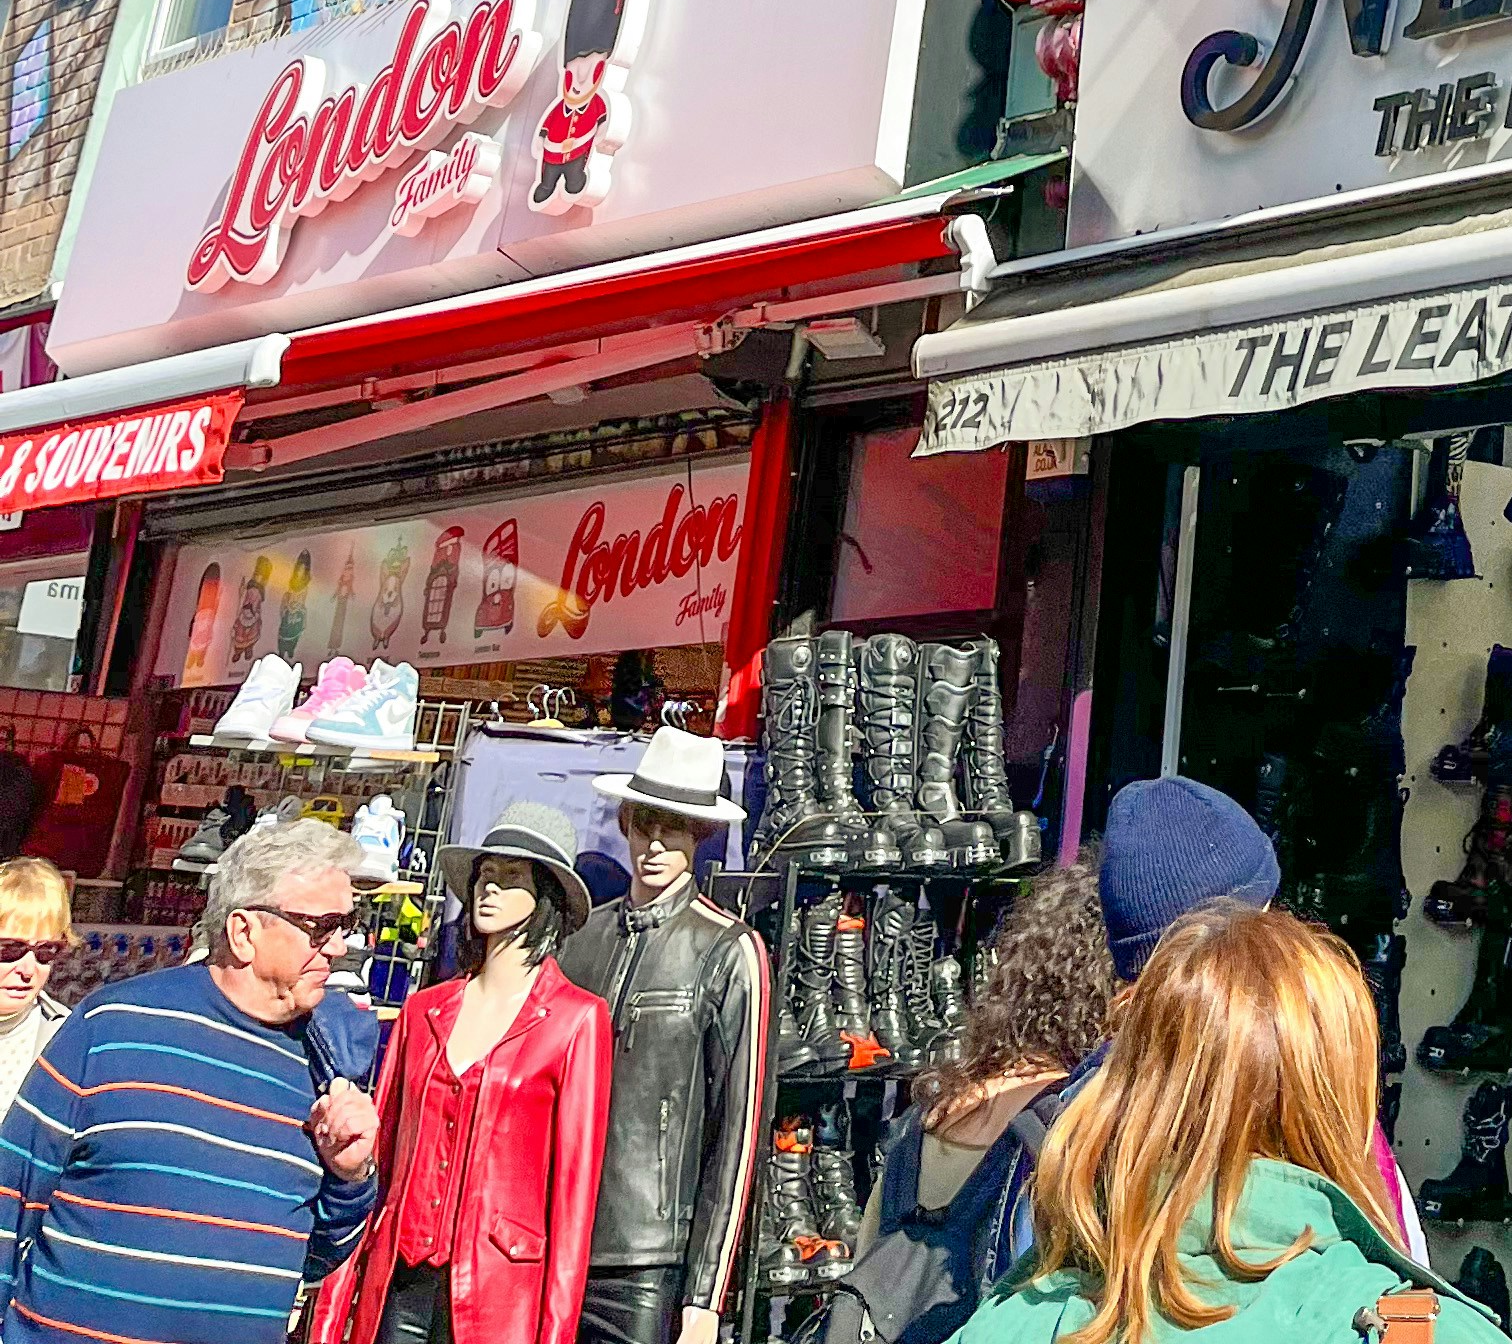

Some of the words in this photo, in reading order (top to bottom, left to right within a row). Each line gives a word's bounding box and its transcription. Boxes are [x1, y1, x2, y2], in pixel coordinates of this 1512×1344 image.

[1372, 70, 1498, 159] THE
[391, 137, 480, 228] Family
[1229, 325, 1345, 401] THE
[0, 439, 34, 499] &
[24, 405, 213, 494] SOUVENIRS
[936, 391, 990, 431] 212
[536, 483, 744, 640] London
[675, 583, 728, 627] Family
